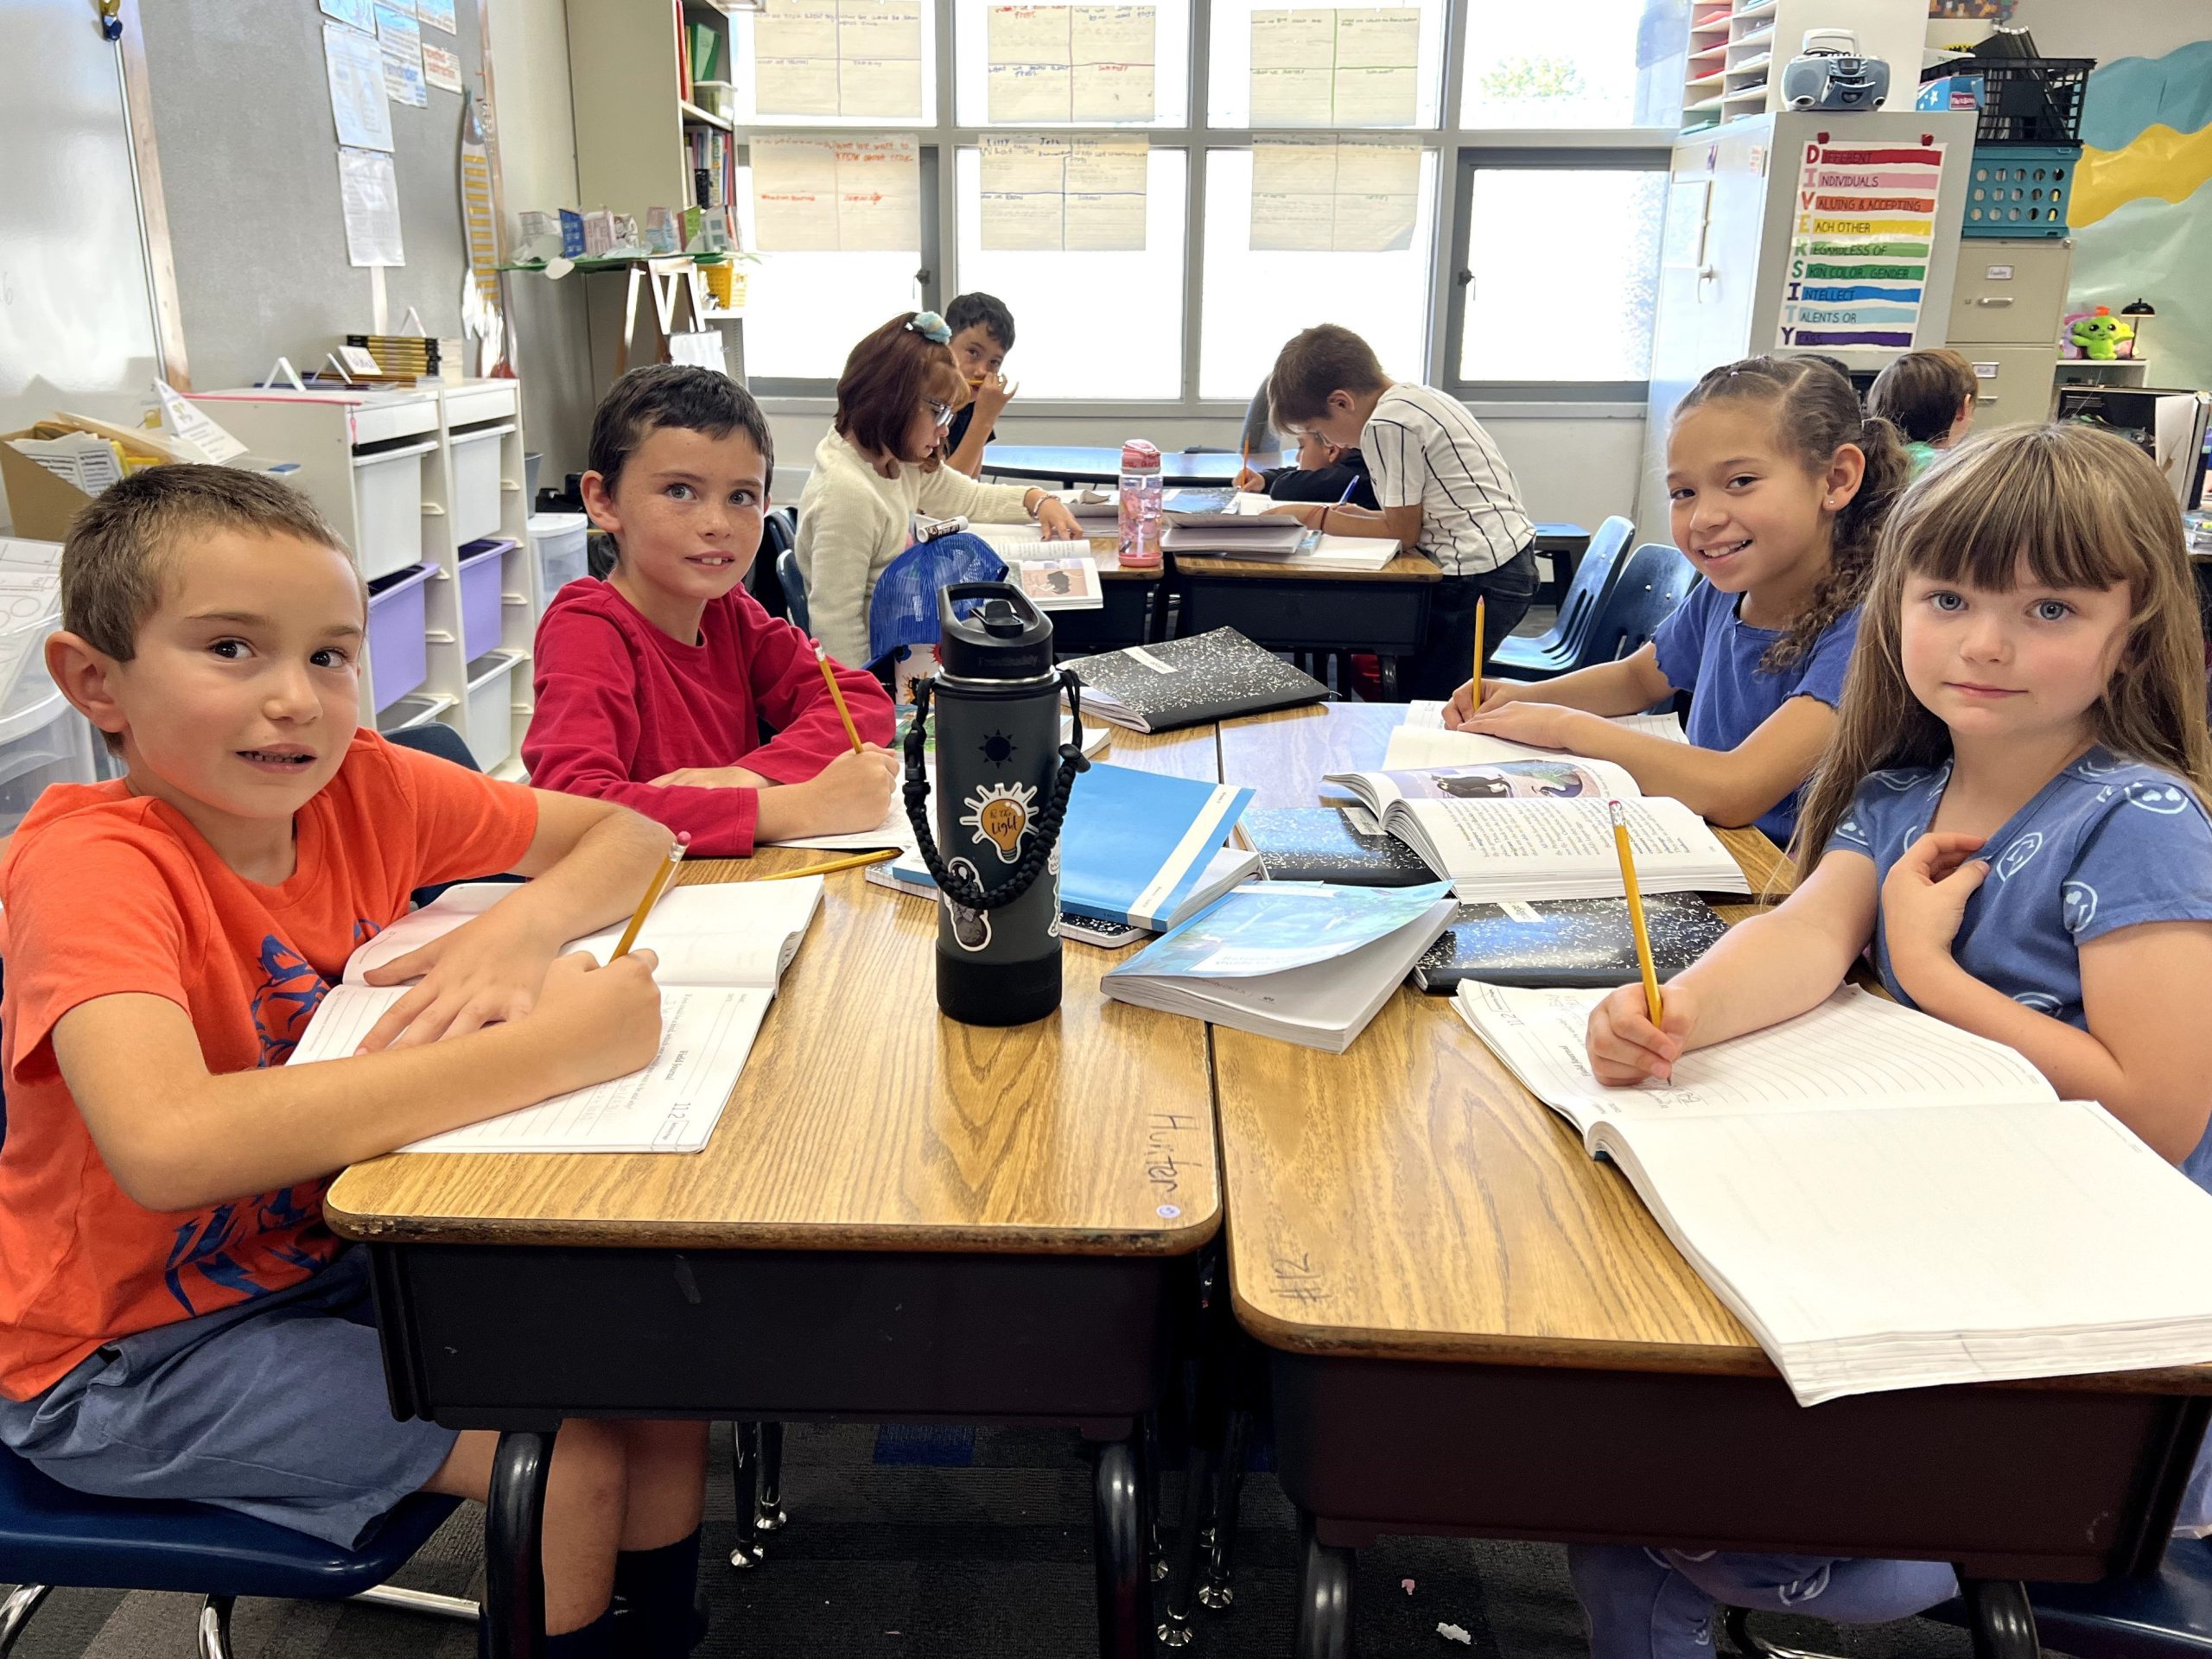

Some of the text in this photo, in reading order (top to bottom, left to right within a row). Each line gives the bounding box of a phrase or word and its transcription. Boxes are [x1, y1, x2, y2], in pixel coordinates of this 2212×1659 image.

[1867, 200, 1922, 211] ACCEPTING
[1838, 222, 1871, 233] OTHER
[1873, 245, 1889, 256] OF
[1870, 268, 1910, 278] GENDER
[1842, 313, 1857, 324] OR
[991, 815, 1018, 837] Light
[664, 1050, 689, 1080] Field Journal
[1557, 1046, 1591, 1076] Field Journal
[666, 1102, 691, 1118] 11.2
